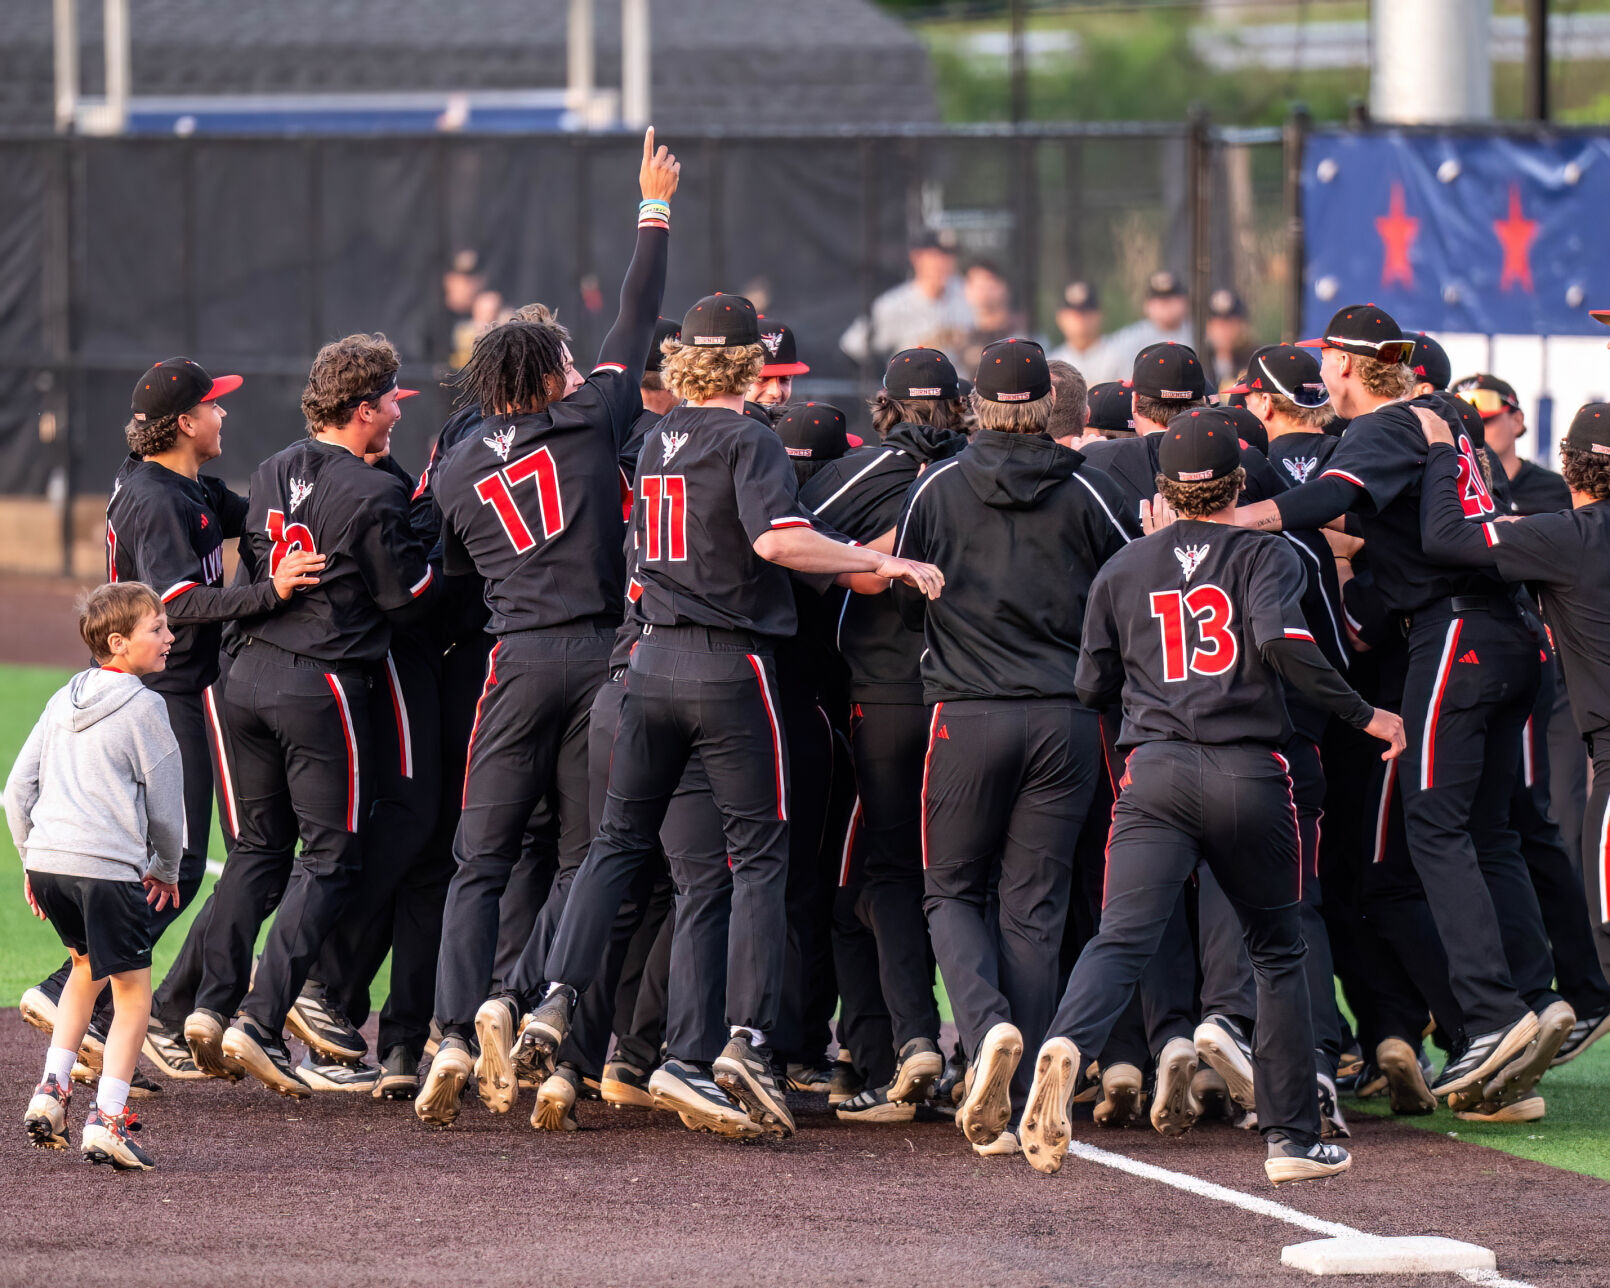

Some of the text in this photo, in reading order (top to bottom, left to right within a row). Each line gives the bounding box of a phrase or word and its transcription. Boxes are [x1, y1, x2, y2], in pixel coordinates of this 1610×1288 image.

[909, 388, 941, 396] HORNETS
[1160, 390, 1193, 399] HORNETS
[473, 445, 564, 555] 17
[641, 475, 687, 561] 11
[1149, 584, 1238, 682] 13
